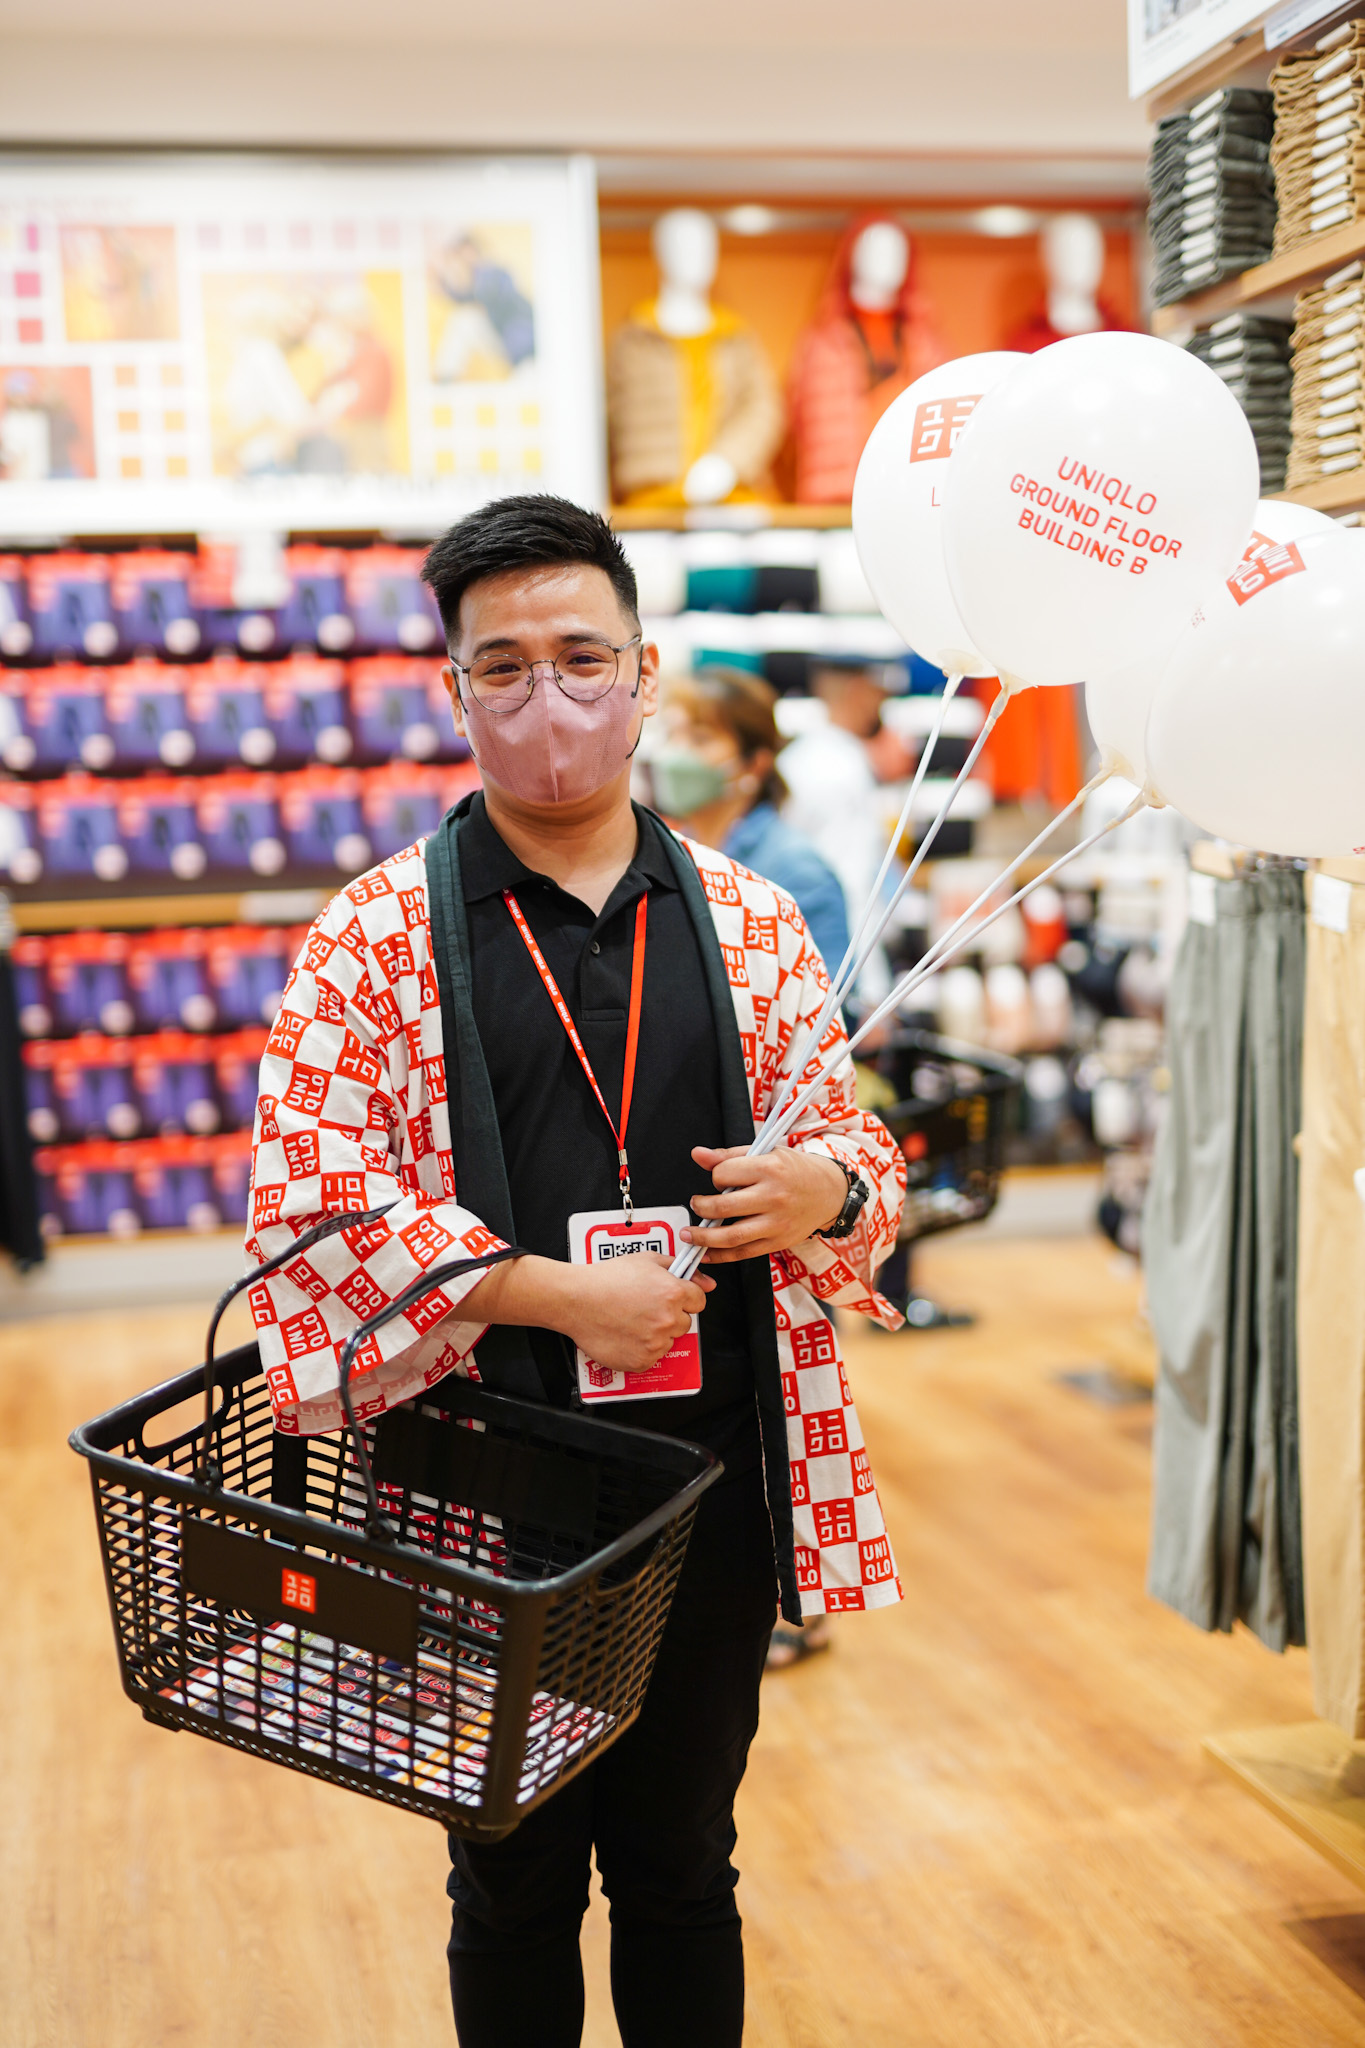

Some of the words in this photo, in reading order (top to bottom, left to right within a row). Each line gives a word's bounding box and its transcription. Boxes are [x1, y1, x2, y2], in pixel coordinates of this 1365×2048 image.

[1057, 456, 1157, 515] UNIQLO
[1010, 473, 1100, 527] GROUND
[1103, 515, 1182, 558] FLOOR
[1018, 508, 1125, 567] BUILDING
[1129, 556, 1148, 575] B
[702, 870, 733, 888] UNI
[402, 890, 425, 909] UN
[705, 885, 738, 902] QLO
[408, 906, 426, 924] QL
[521, 924, 533, 944] UNIQLO
[533, 949, 546, 970] UNIQLO
[722, 948, 742, 965] NI
[545, 975, 558, 996] UNIQLO
[728, 966, 747, 983] LO
[377, 996, 392, 1015] NI
[557, 1001, 570, 1023] UNIQLO
[381, 1013, 400, 1036] LO
[287, 1073, 309, 1107] UNI
[304, 1074, 325, 1110] QLO
[286, 1142, 303, 1176] UNI
[298, 1134, 317, 1172] QLO
[419, 1220, 448, 1248] QLO
[407, 1230, 434, 1262] UNI
[342, 1287, 370, 1318] UNI
[353, 1275, 382, 1307] QLO
[286, 1322, 307, 1354] UNI
[303, 1313, 327, 1347] QLO
[796, 1551, 813, 1568] NI
[863, 1540, 887, 1561] UNI
[797, 1569, 818, 1587] LO
[865, 1559, 891, 1582] QLO
